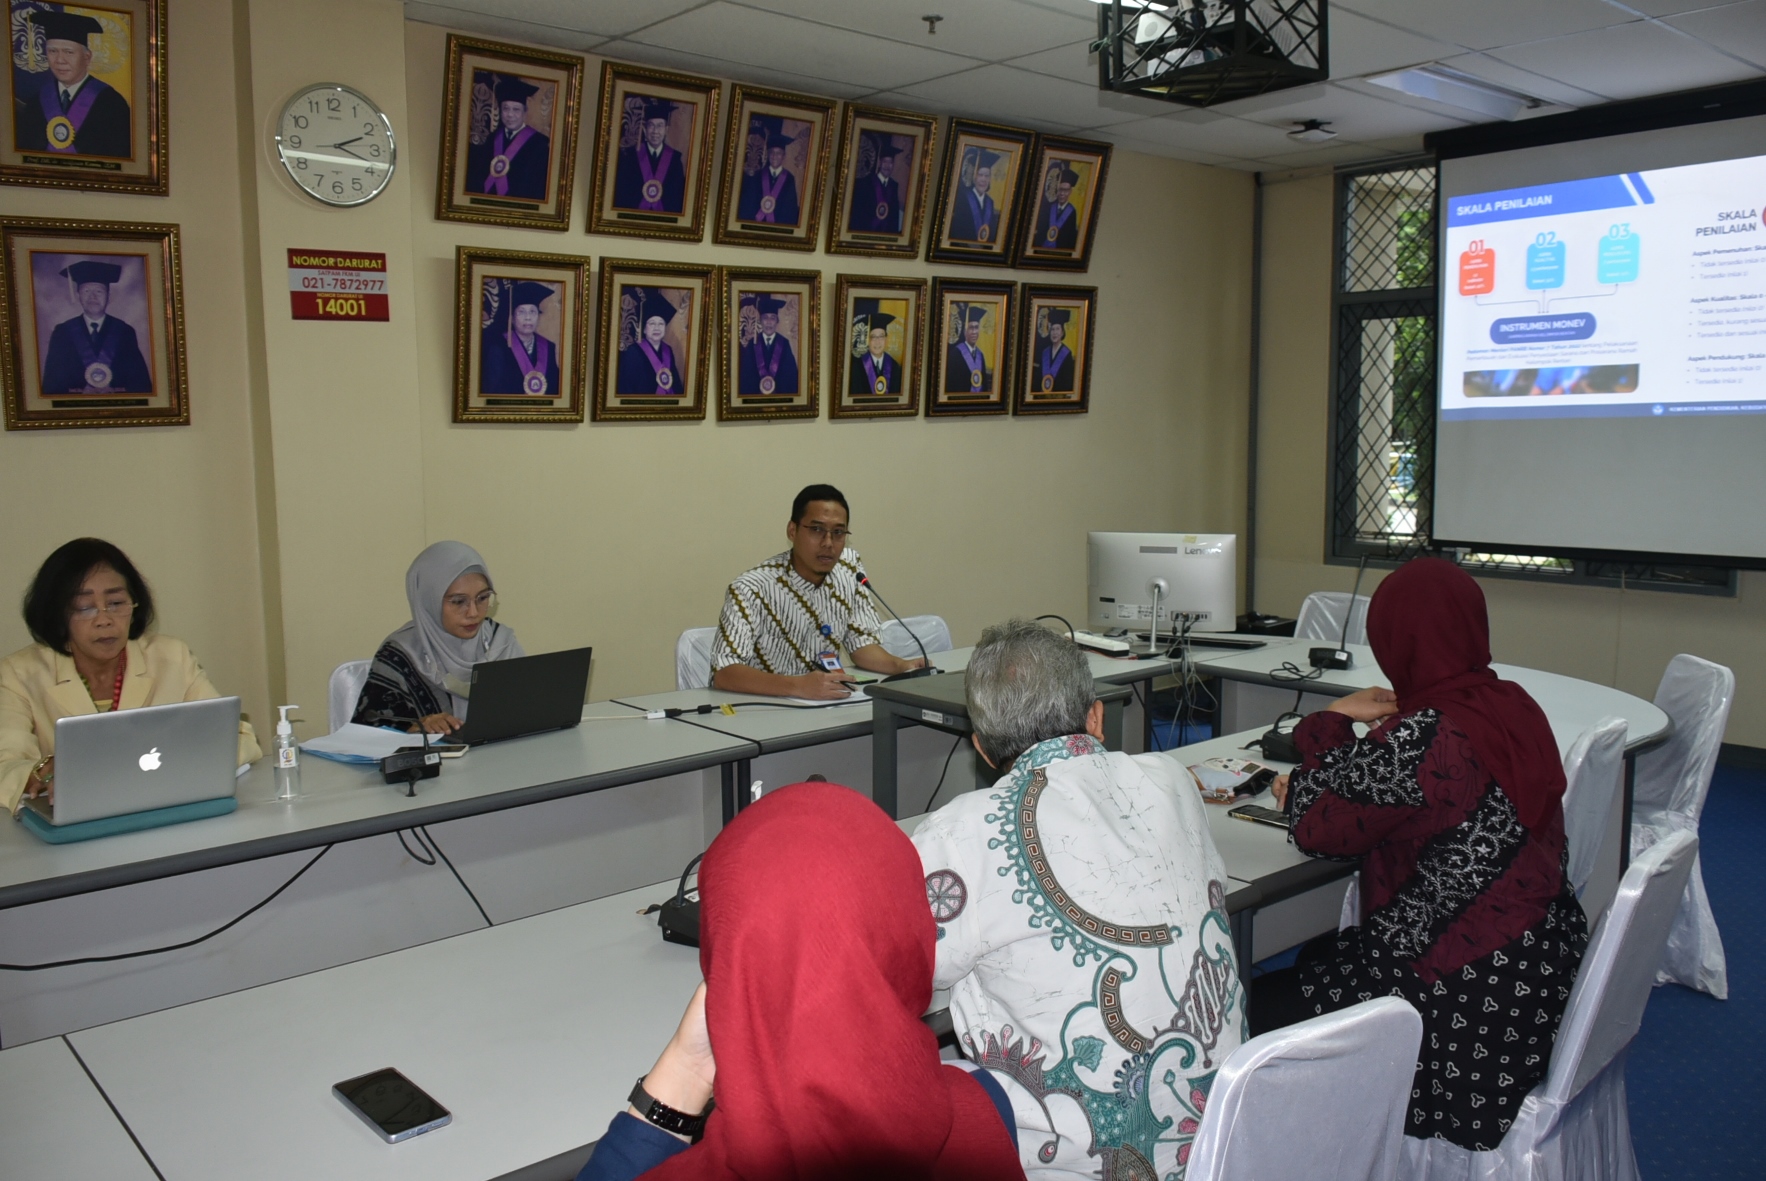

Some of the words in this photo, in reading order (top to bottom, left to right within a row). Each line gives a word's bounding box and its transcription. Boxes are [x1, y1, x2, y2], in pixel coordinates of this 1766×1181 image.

[308, 100, 319, 114] 11
[326, 98, 341, 112] 12
[352, 105, 357, 118] 1
[293, 115, 309, 129] 10
[363, 122, 375, 136] 2
[289, 135, 302, 149] 9
[369, 144, 380, 157] 3
[296, 157, 308, 170] 8
[364, 163, 375, 176] 4
[313, 173, 325, 187] 7
[351, 178, 363, 191] 5
[332, 181, 344, 195] 6
[1456, 203, 1492, 216] SKALA
[1494, 195, 1553, 212] PENILAIAN
[1717, 208, 1757, 222] SKALA
[1608, 223, 1631, 240] 03
[1695, 222, 1757, 237] PENILAIAN
[1535, 231, 1557, 248] 02
[1469, 239, 1486, 256] 01
[292, 256, 335, 267] NOMOR
[337, 258, 383, 269] DARURAT
[302, 277, 384, 291] 021-7872977
[316, 298, 366, 316] 14001
[1499, 320, 1551, 333] INSTRUMEN
[1552, 318, 1587, 330] MONEV
